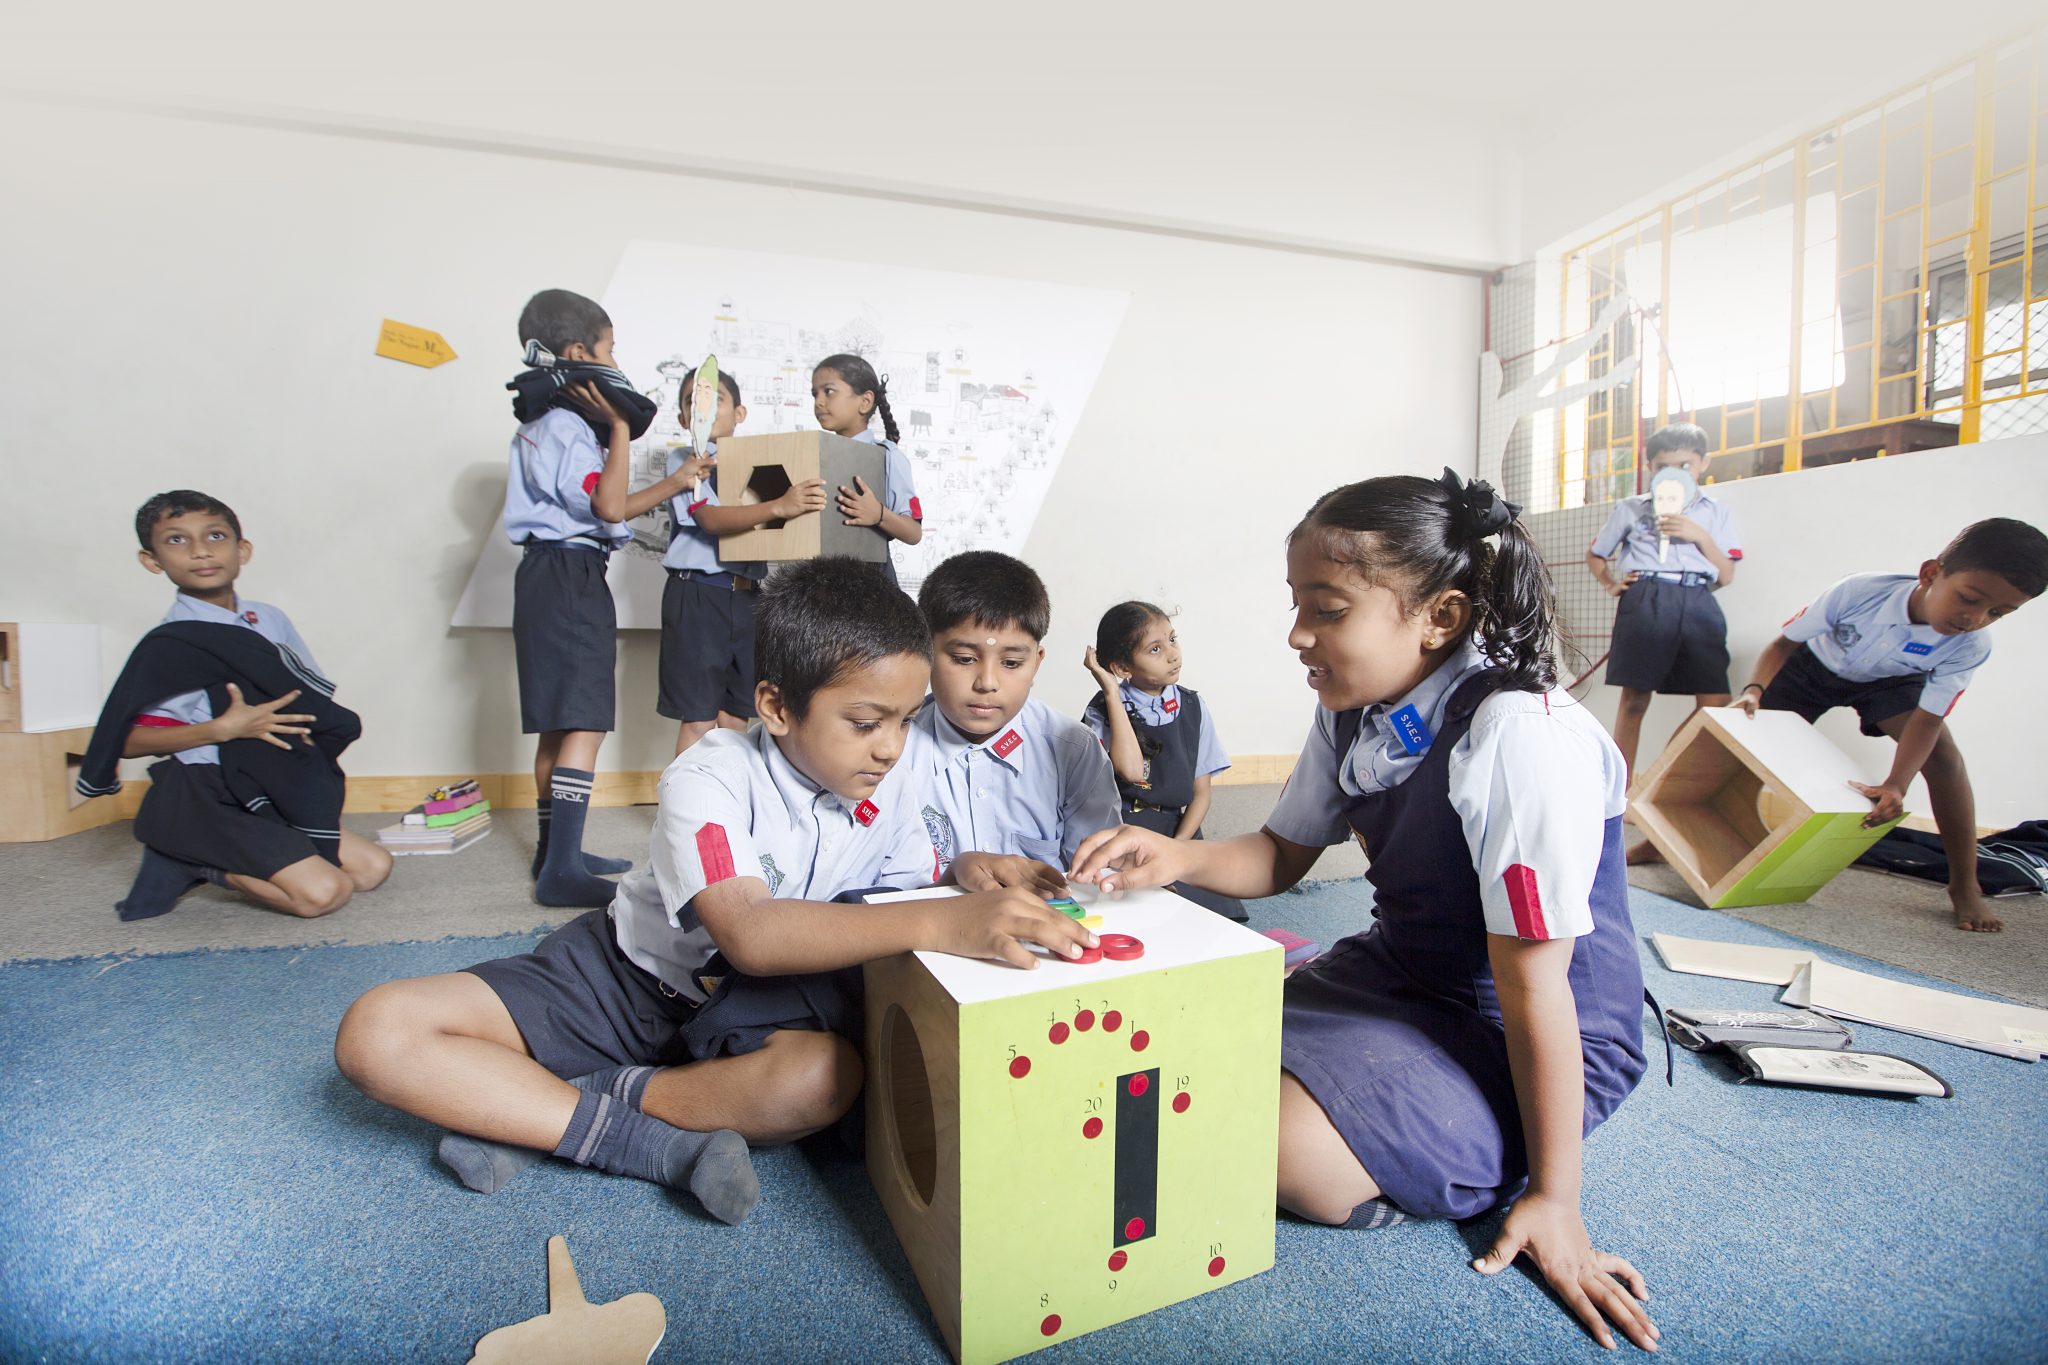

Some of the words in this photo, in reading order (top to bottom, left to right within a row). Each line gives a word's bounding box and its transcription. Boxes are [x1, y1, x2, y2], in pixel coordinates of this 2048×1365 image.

[1401, 714, 1422, 744] S.V.E.C
[1074, 998, 1082, 1013] 3
[1101, 1000, 1109, 1014] 2
[1047, 1011, 1056, 1025] 4
[1006, 1044, 1017, 1060] 5
[1176, 1075, 1190, 1091] 19
[1084, 1096, 1103, 1114] 20
[1209, 1242, 1222, 1258] 10
[1108, 1279, 1118, 1294] 9
[1040, 1293, 1049, 1308] 8
